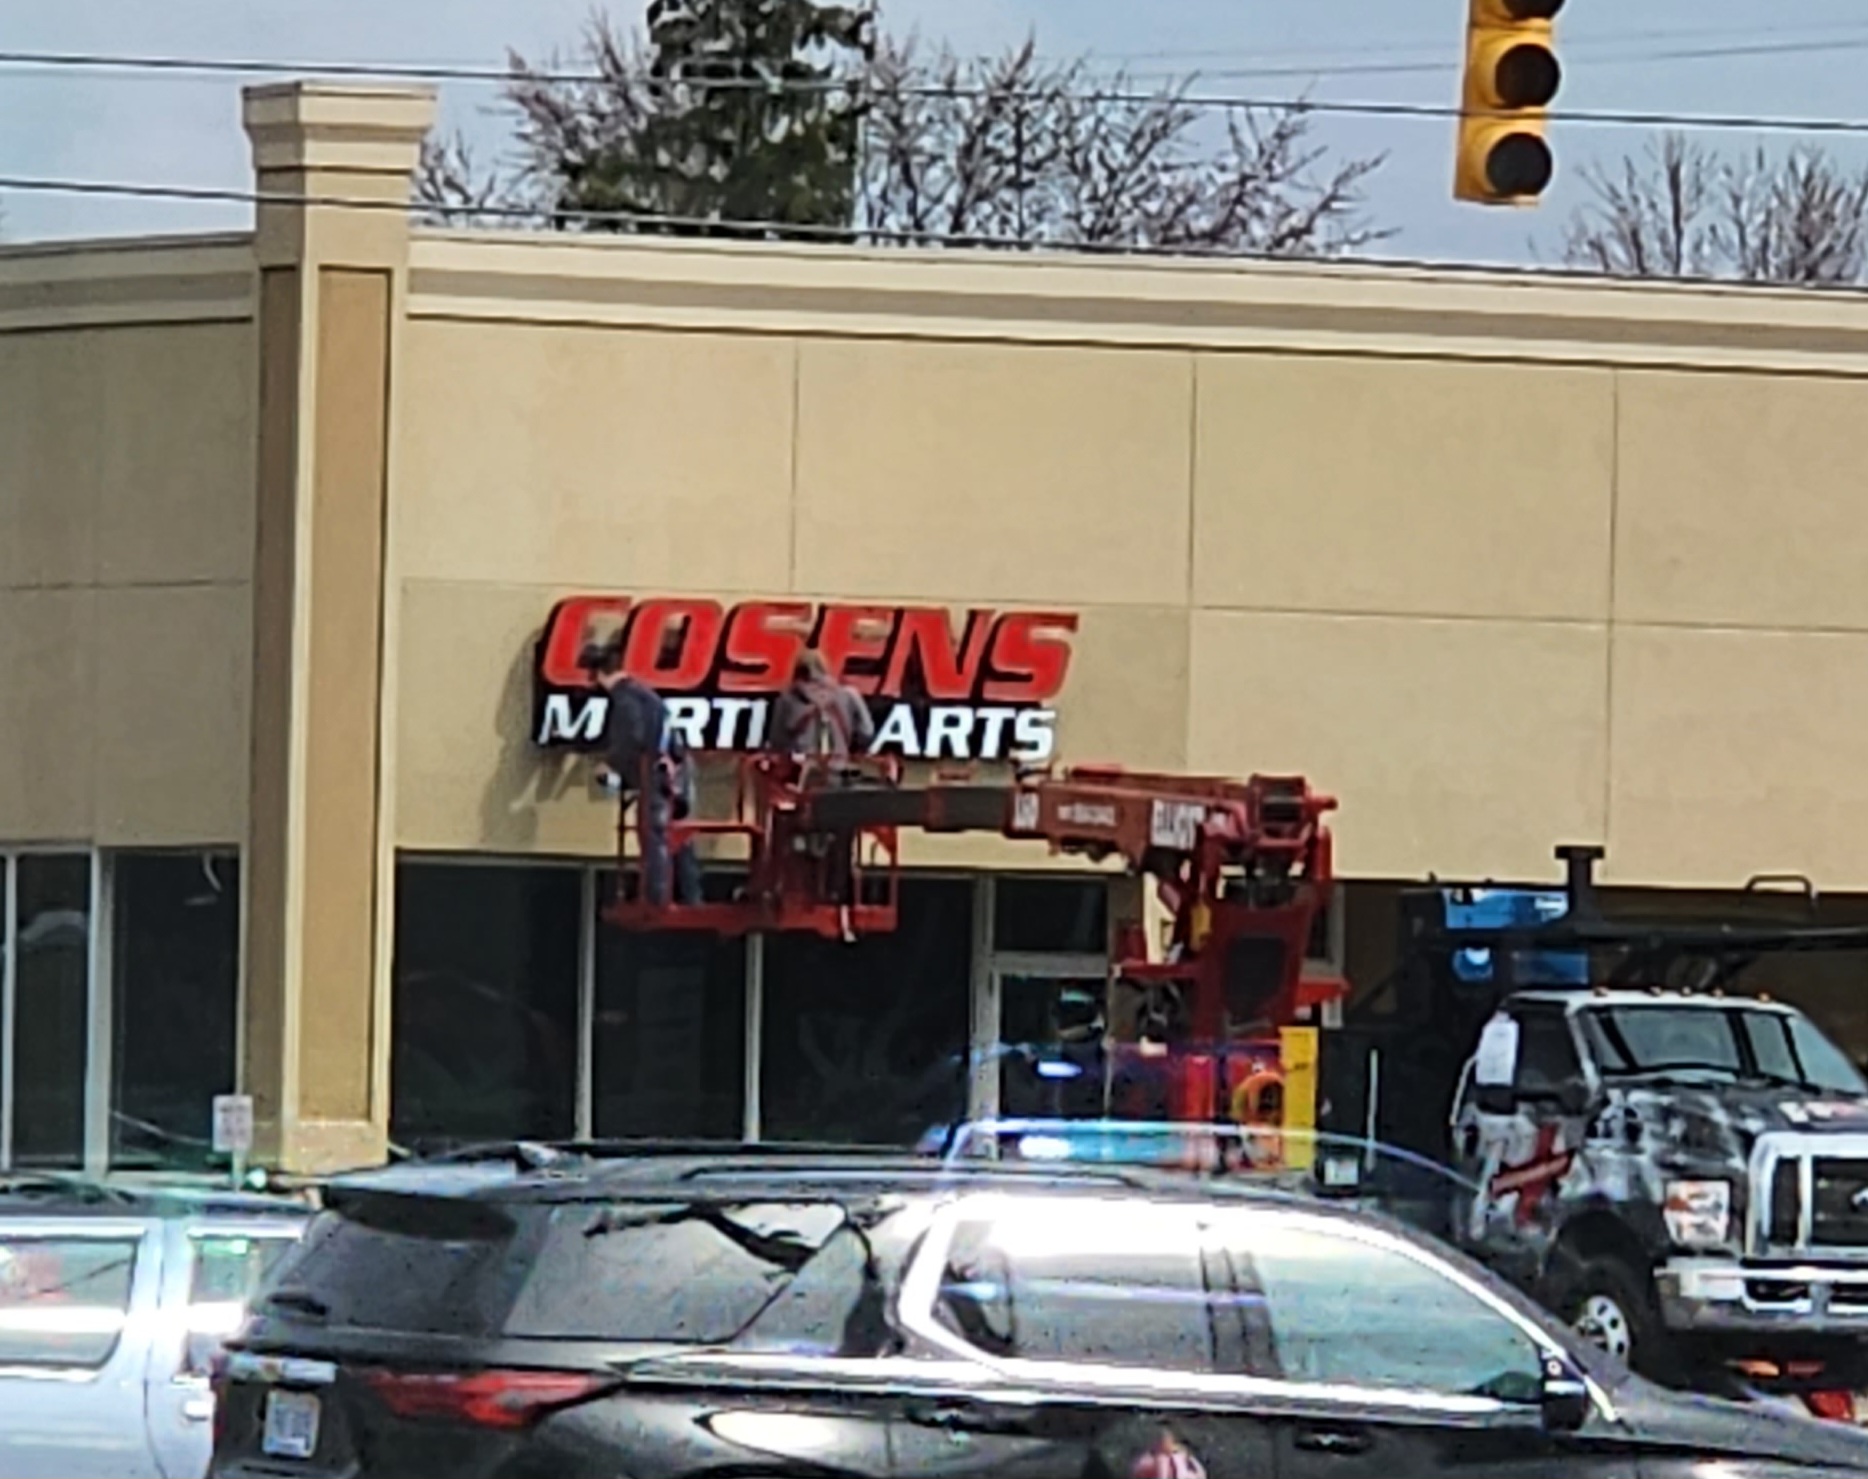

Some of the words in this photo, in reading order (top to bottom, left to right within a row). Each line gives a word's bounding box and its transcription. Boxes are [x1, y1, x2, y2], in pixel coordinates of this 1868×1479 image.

[541, 594, 1079, 703] COSENS
[538, 694, 769, 749] MRTI
[868, 701, 1057, 761] ARTS
